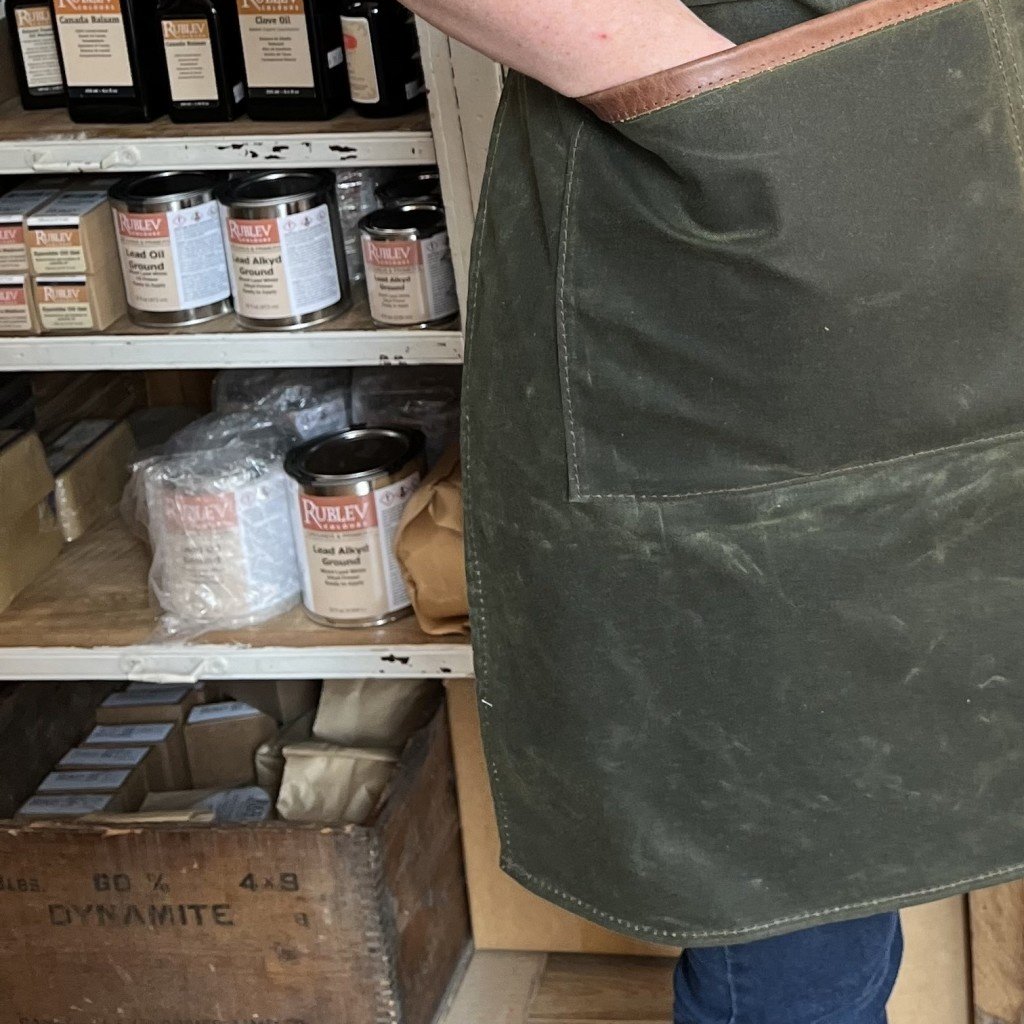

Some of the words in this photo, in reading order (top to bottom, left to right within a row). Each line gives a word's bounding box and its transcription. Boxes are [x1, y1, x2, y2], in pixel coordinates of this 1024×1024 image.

[59, 16, 89, 25] Canada
[91, 15, 120, 24] Balsam
[255, 16, 277, 25] Clove
[279, 16, 291, 24] Oil
[162, 21, 206, 38] RUBLEV
[119, 212, 162, 233] RUBLEV
[228, 219, 272, 239] RUBLEV
[35, 229, 74, 246] RUBLEV
[125, 248, 147, 260] Lead
[149, 249, 165, 259] Oil
[368, 241, 411, 262] RUBLEV
[128, 260, 165, 271] Ground
[253, 256, 282, 268] Alkyd
[239, 267, 274, 276] Ground
[303, 498, 371, 527] RUBLEV
[312, 544, 336, 556] Lead
[337, 545, 370, 557] Alkyd
[321, 556, 362, 567] Ground
[47, 903, 236, 927] DYNAMITE
